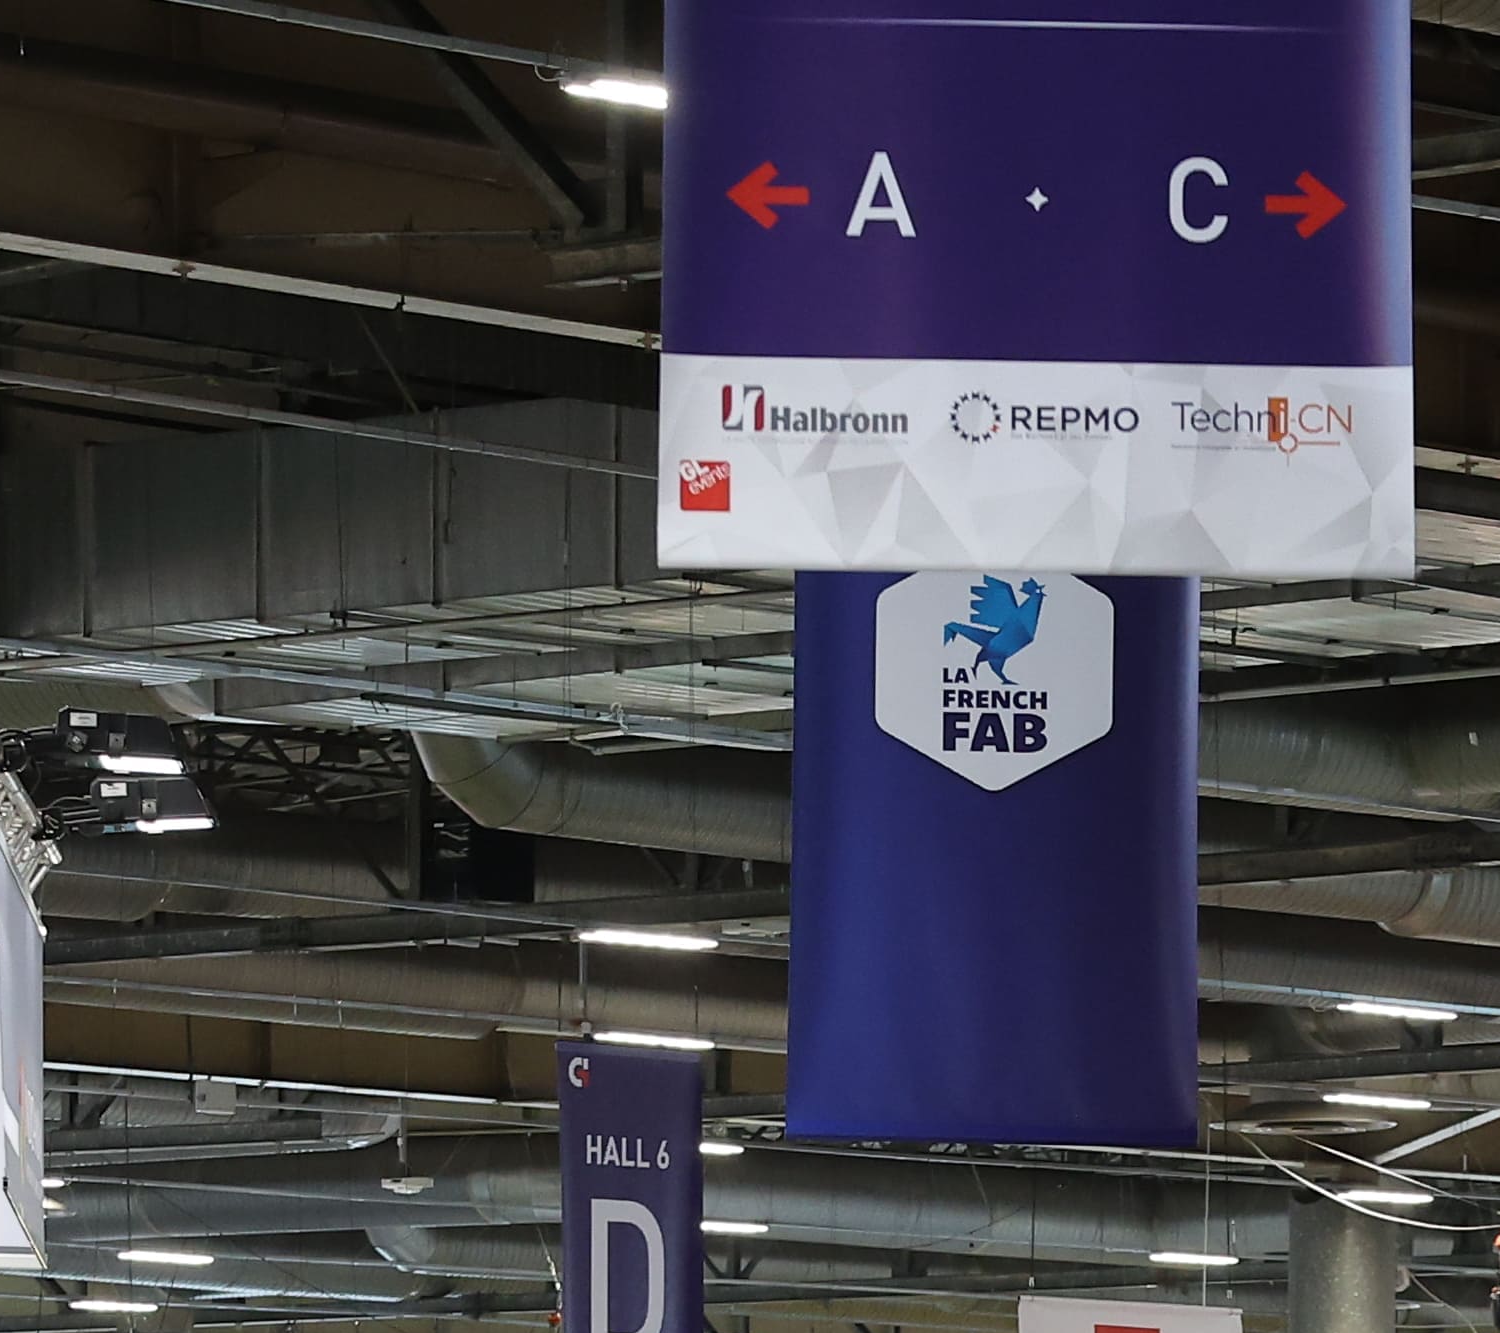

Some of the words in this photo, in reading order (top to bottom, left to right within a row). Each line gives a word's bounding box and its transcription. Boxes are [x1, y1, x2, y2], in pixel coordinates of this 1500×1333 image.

[846, 151, 916, 237] A
[1169, 157, 1228, 243] C
[770, 407, 908, 433] Halbronn
[1011, 406, 1139, 432] REPMO
[943, 668, 969, 683] LA
[943, 690, 1047, 709] FRENCH
[942, 712, 1047, 753] FAB
[587, 1135, 650, 1168] HALL
[657, 1140, 670, 1169] 6
